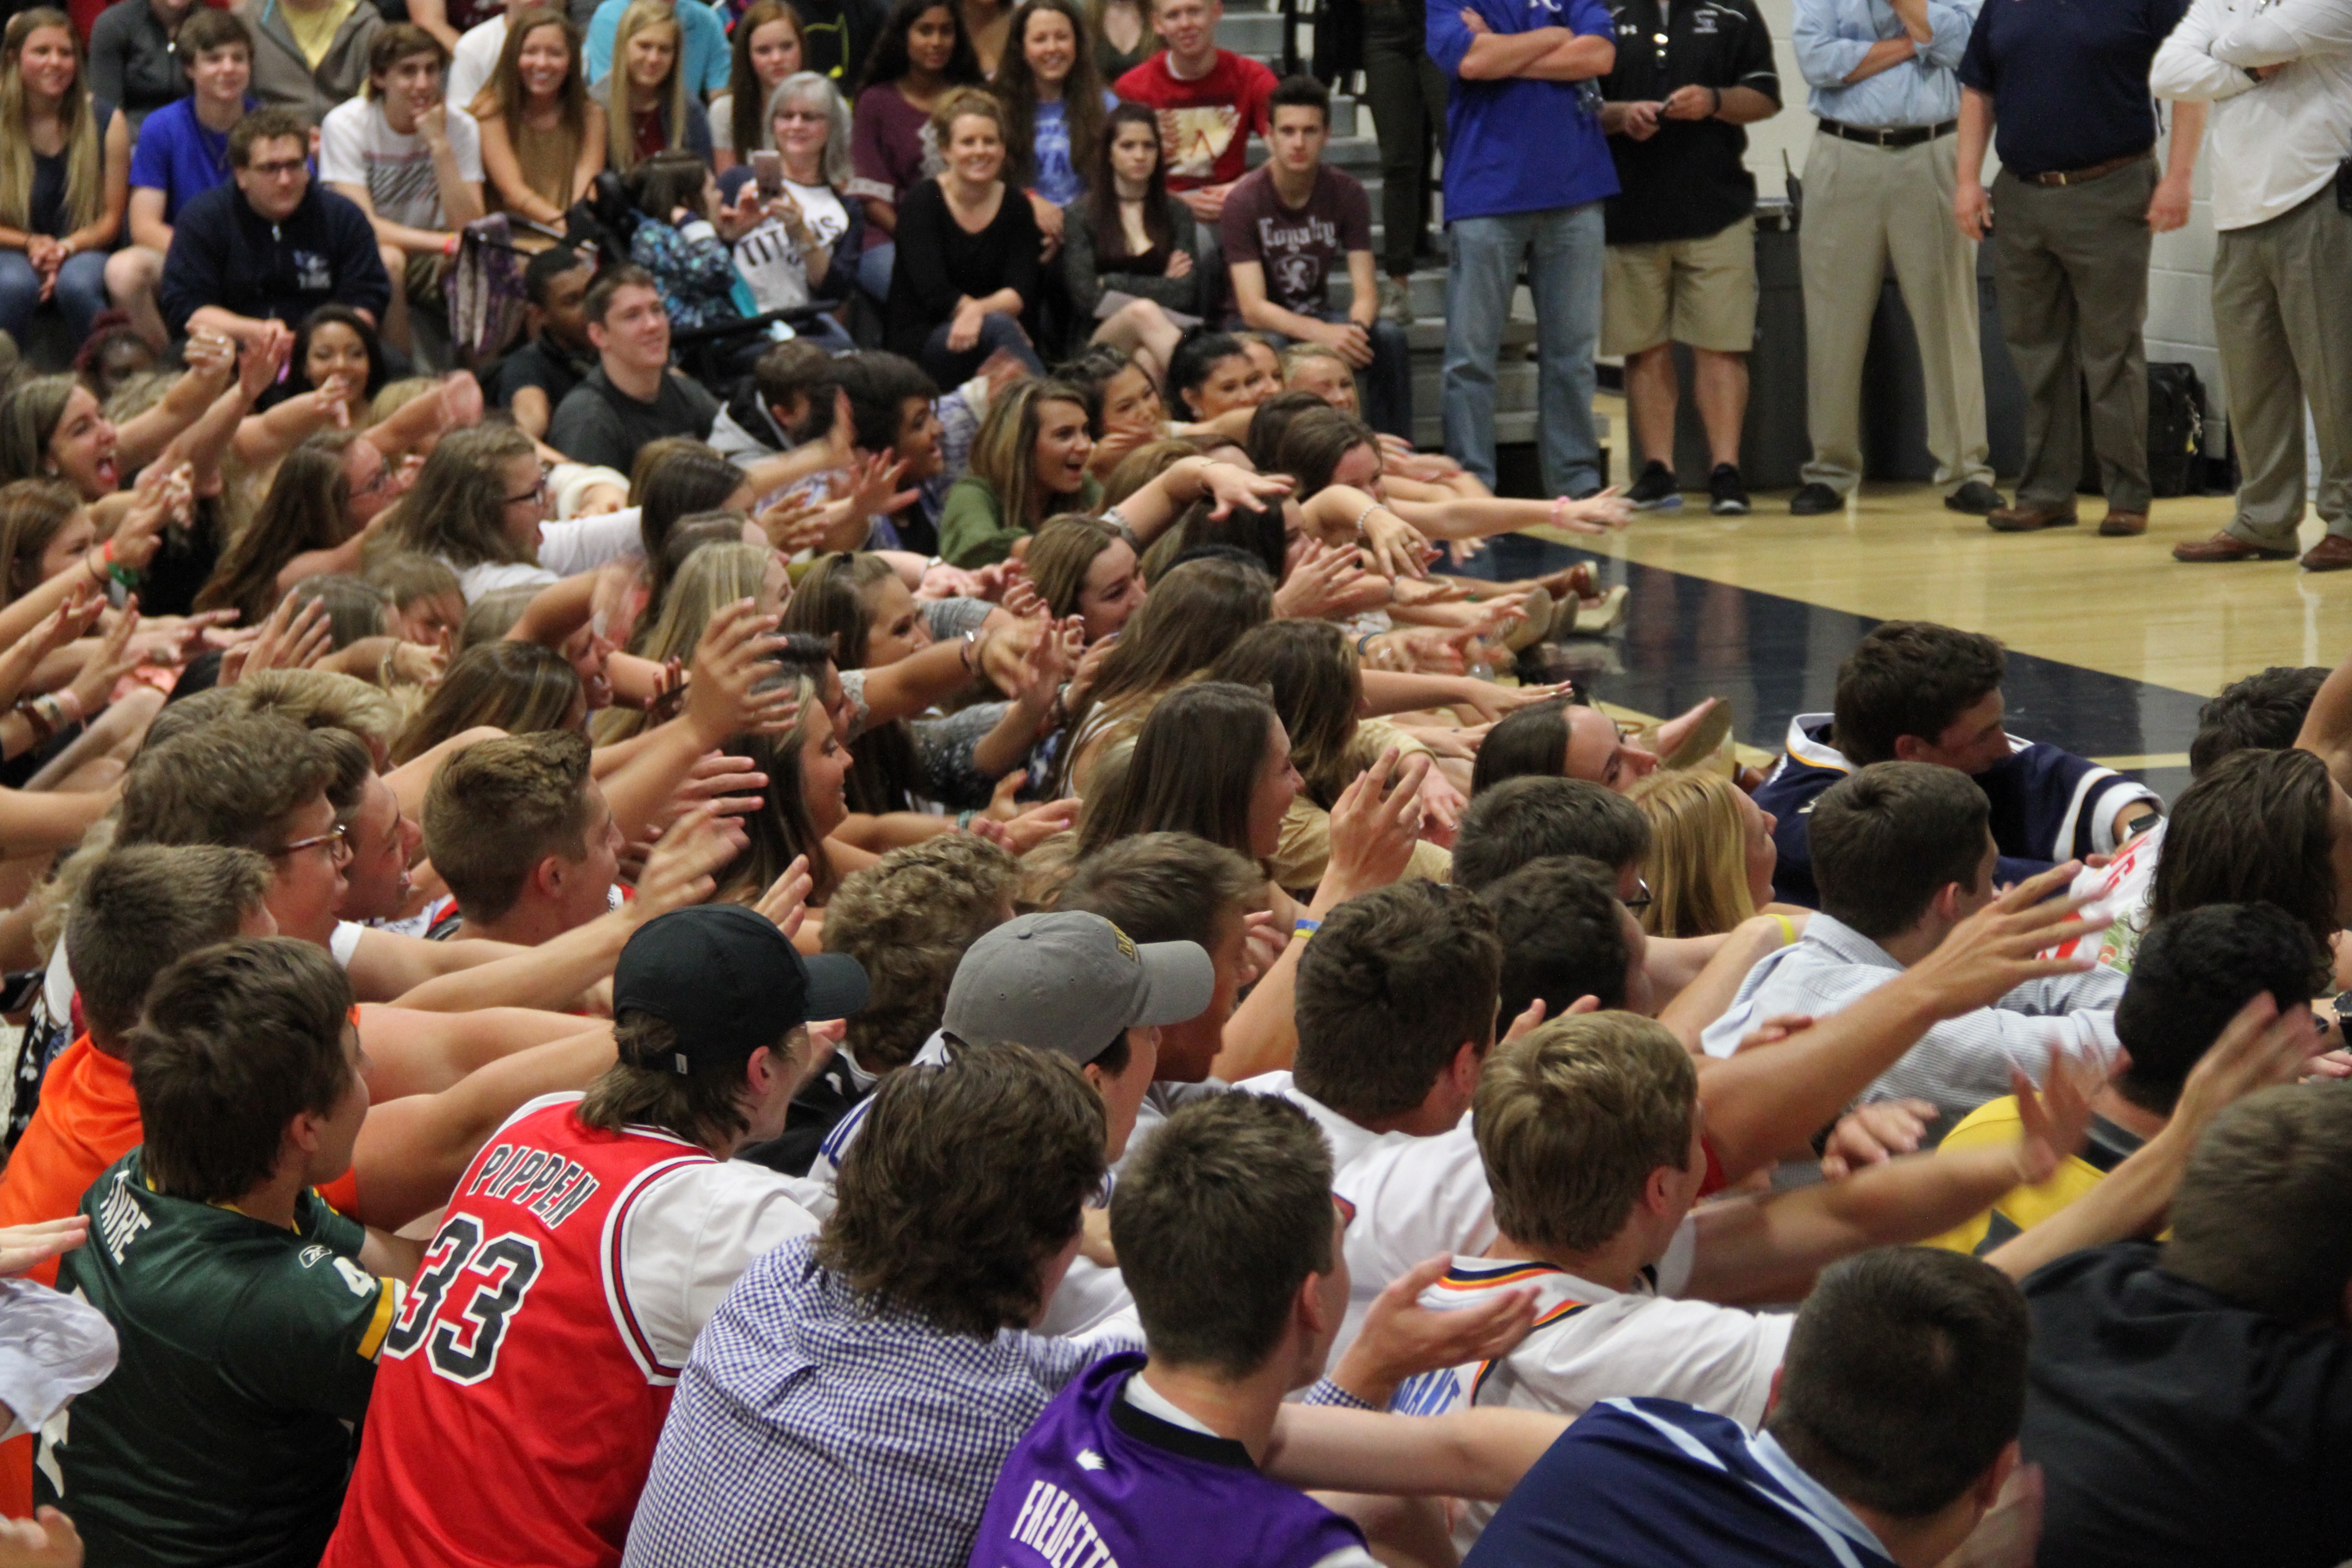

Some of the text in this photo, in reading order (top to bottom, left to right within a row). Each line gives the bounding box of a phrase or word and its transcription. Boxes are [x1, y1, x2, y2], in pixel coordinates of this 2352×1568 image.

[466, 1144, 600, 1230] PIPPEN
[383, 1211, 544, 1387] 33
[1010, 1480, 1119, 1568] FREDETT
